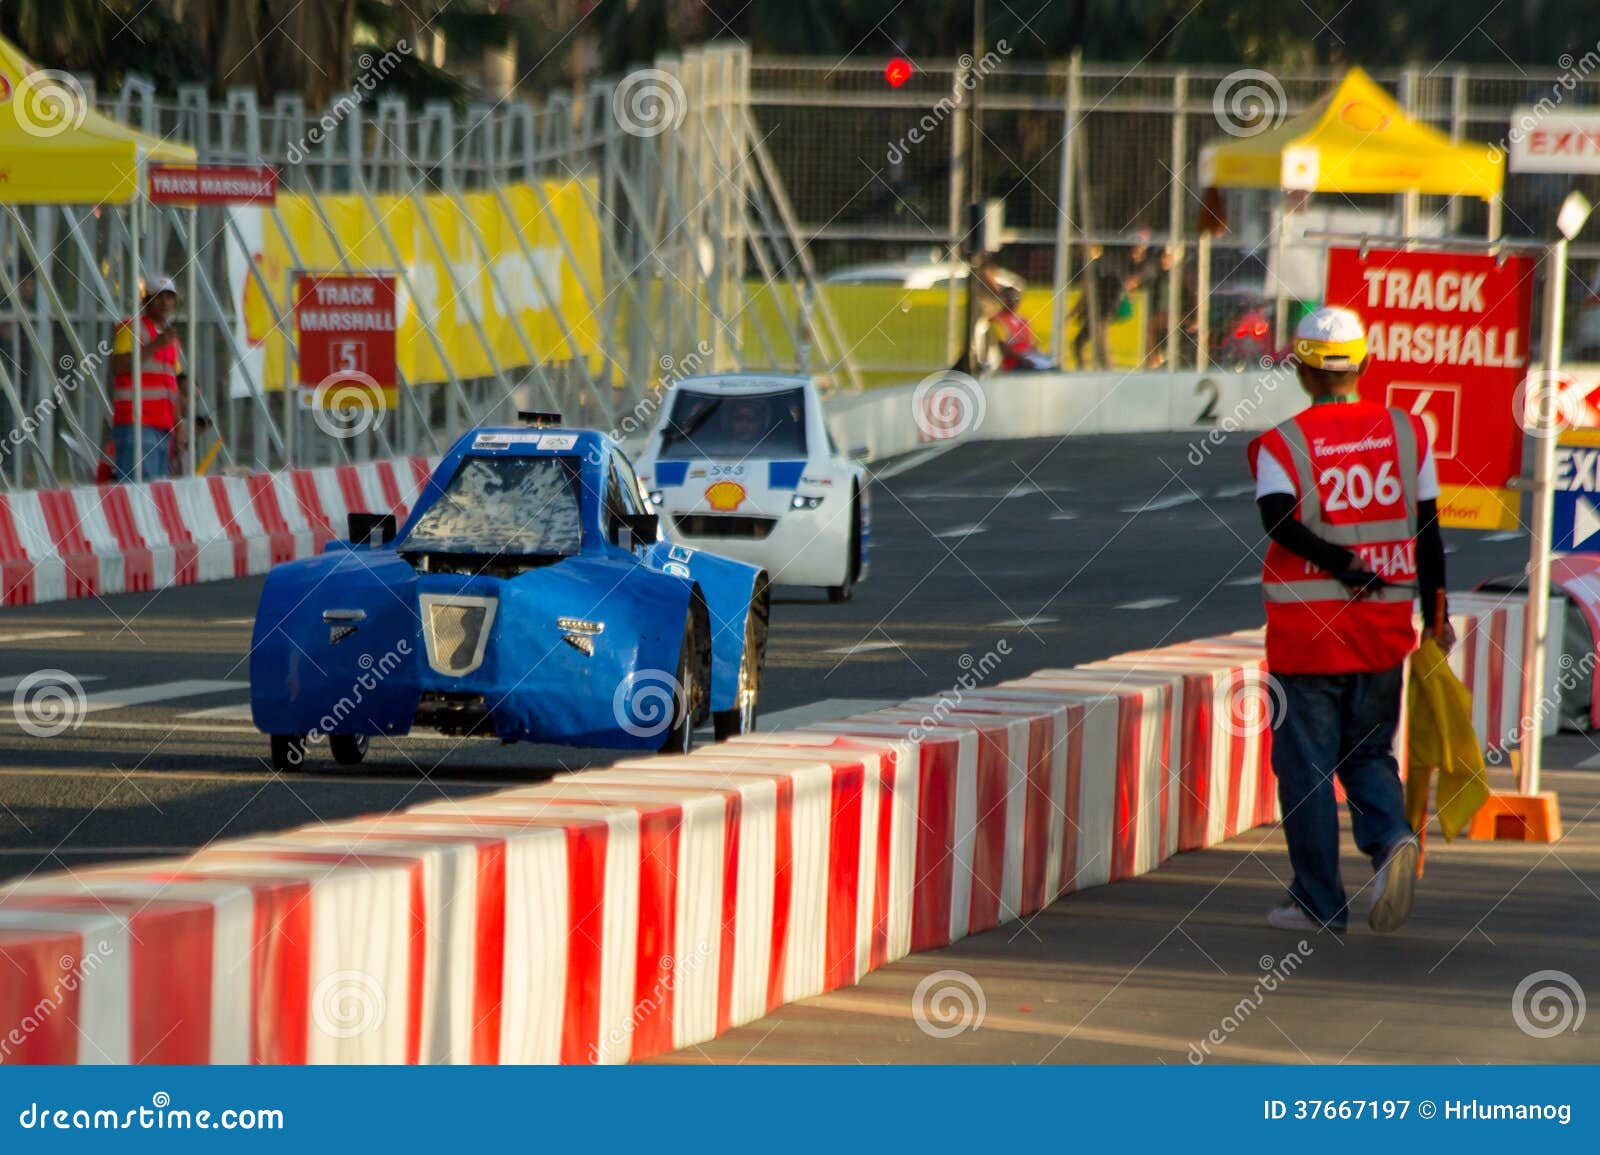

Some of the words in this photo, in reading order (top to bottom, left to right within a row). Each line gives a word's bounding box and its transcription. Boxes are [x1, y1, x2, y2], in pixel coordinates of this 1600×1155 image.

[153, 175, 198, 194] TRACK
[200, 178, 273, 197] MARSHALL
[315, 284, 375, 305] TRACK
[1363, 267, 1487, 313] TRACK
[300, 311, 395, 331] MARSHALL
[340, 342, 357, 374] 5
[1367, 322, 1527, 368] ARSHALL
[1193, 378, 1219, 426] 2
[1320, 460, 1402, 512] 206
